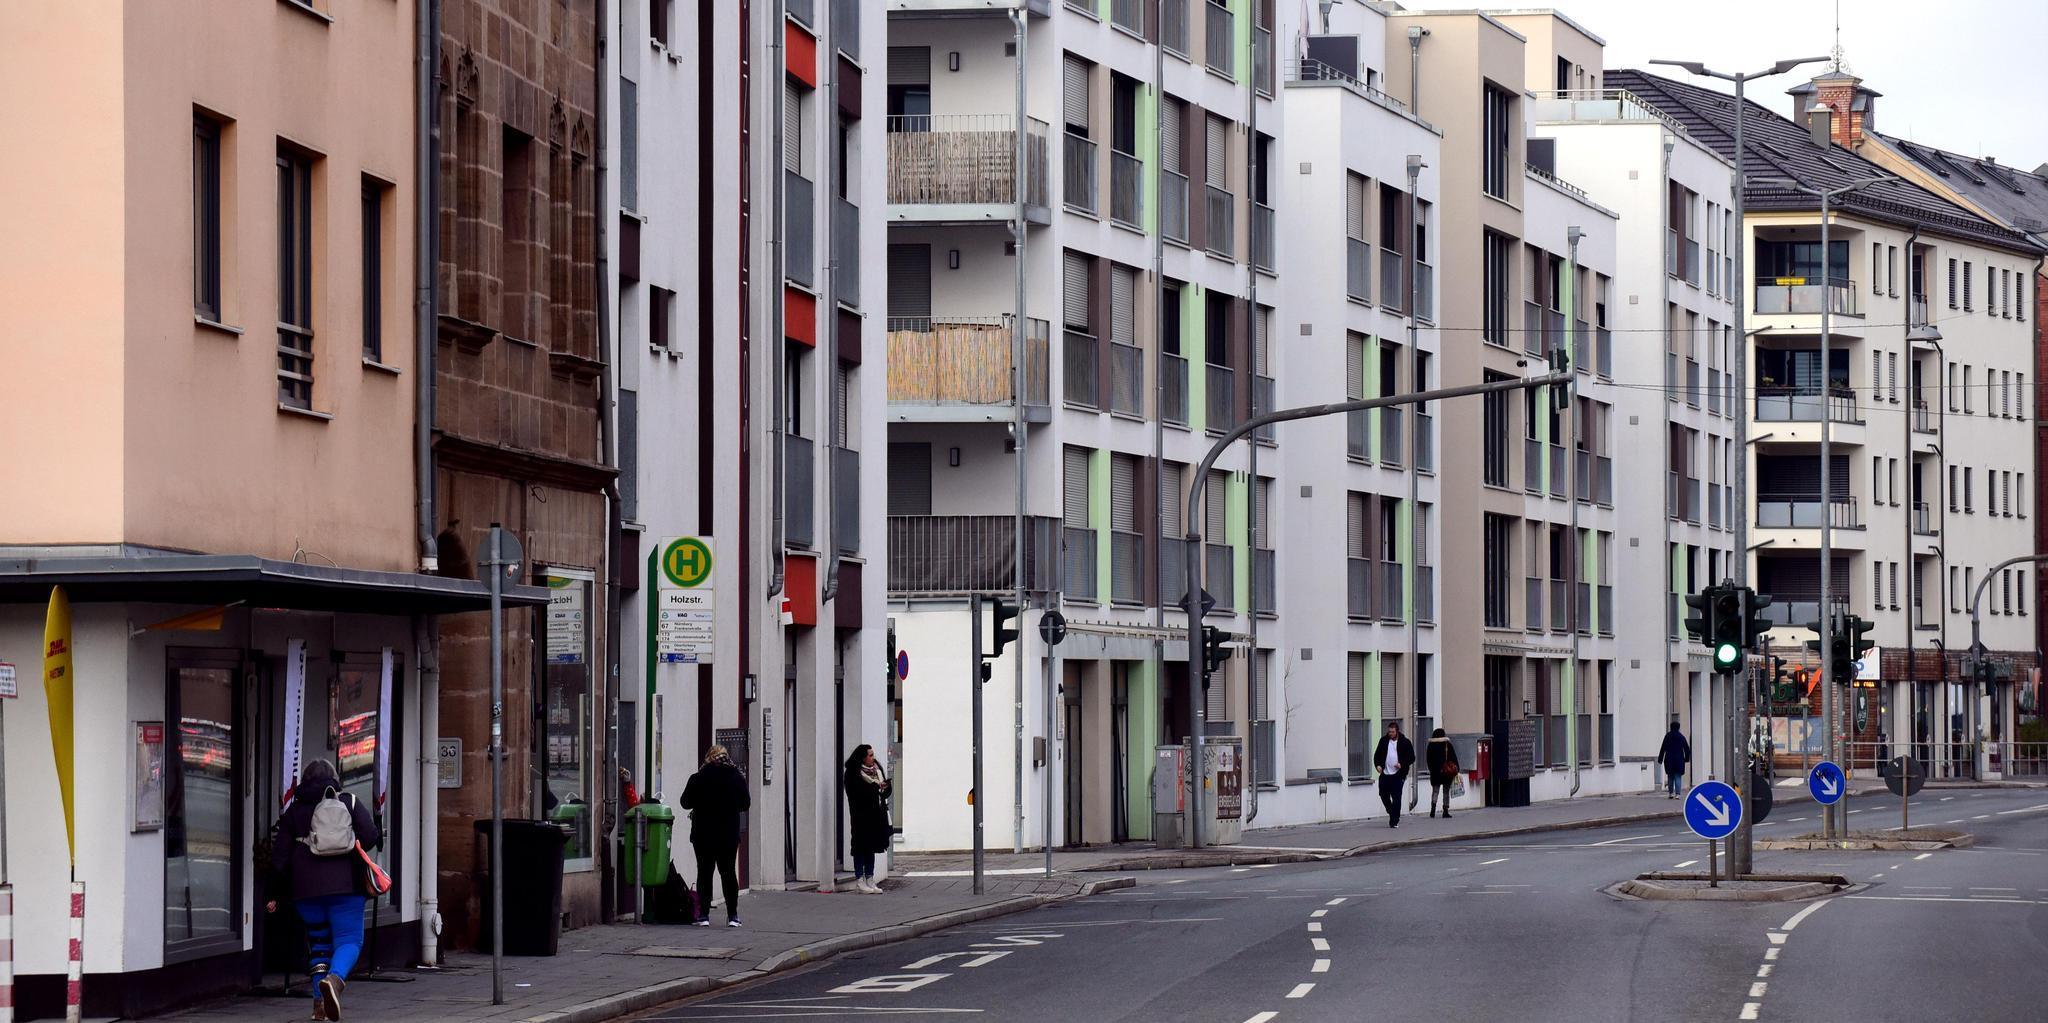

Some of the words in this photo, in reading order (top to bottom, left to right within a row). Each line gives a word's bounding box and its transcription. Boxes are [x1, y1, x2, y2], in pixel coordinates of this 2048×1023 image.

[676, 549, 699, 576] H
[670, 595, 703, 604] Holzstr.
[441, 745, 457, 758] 36
